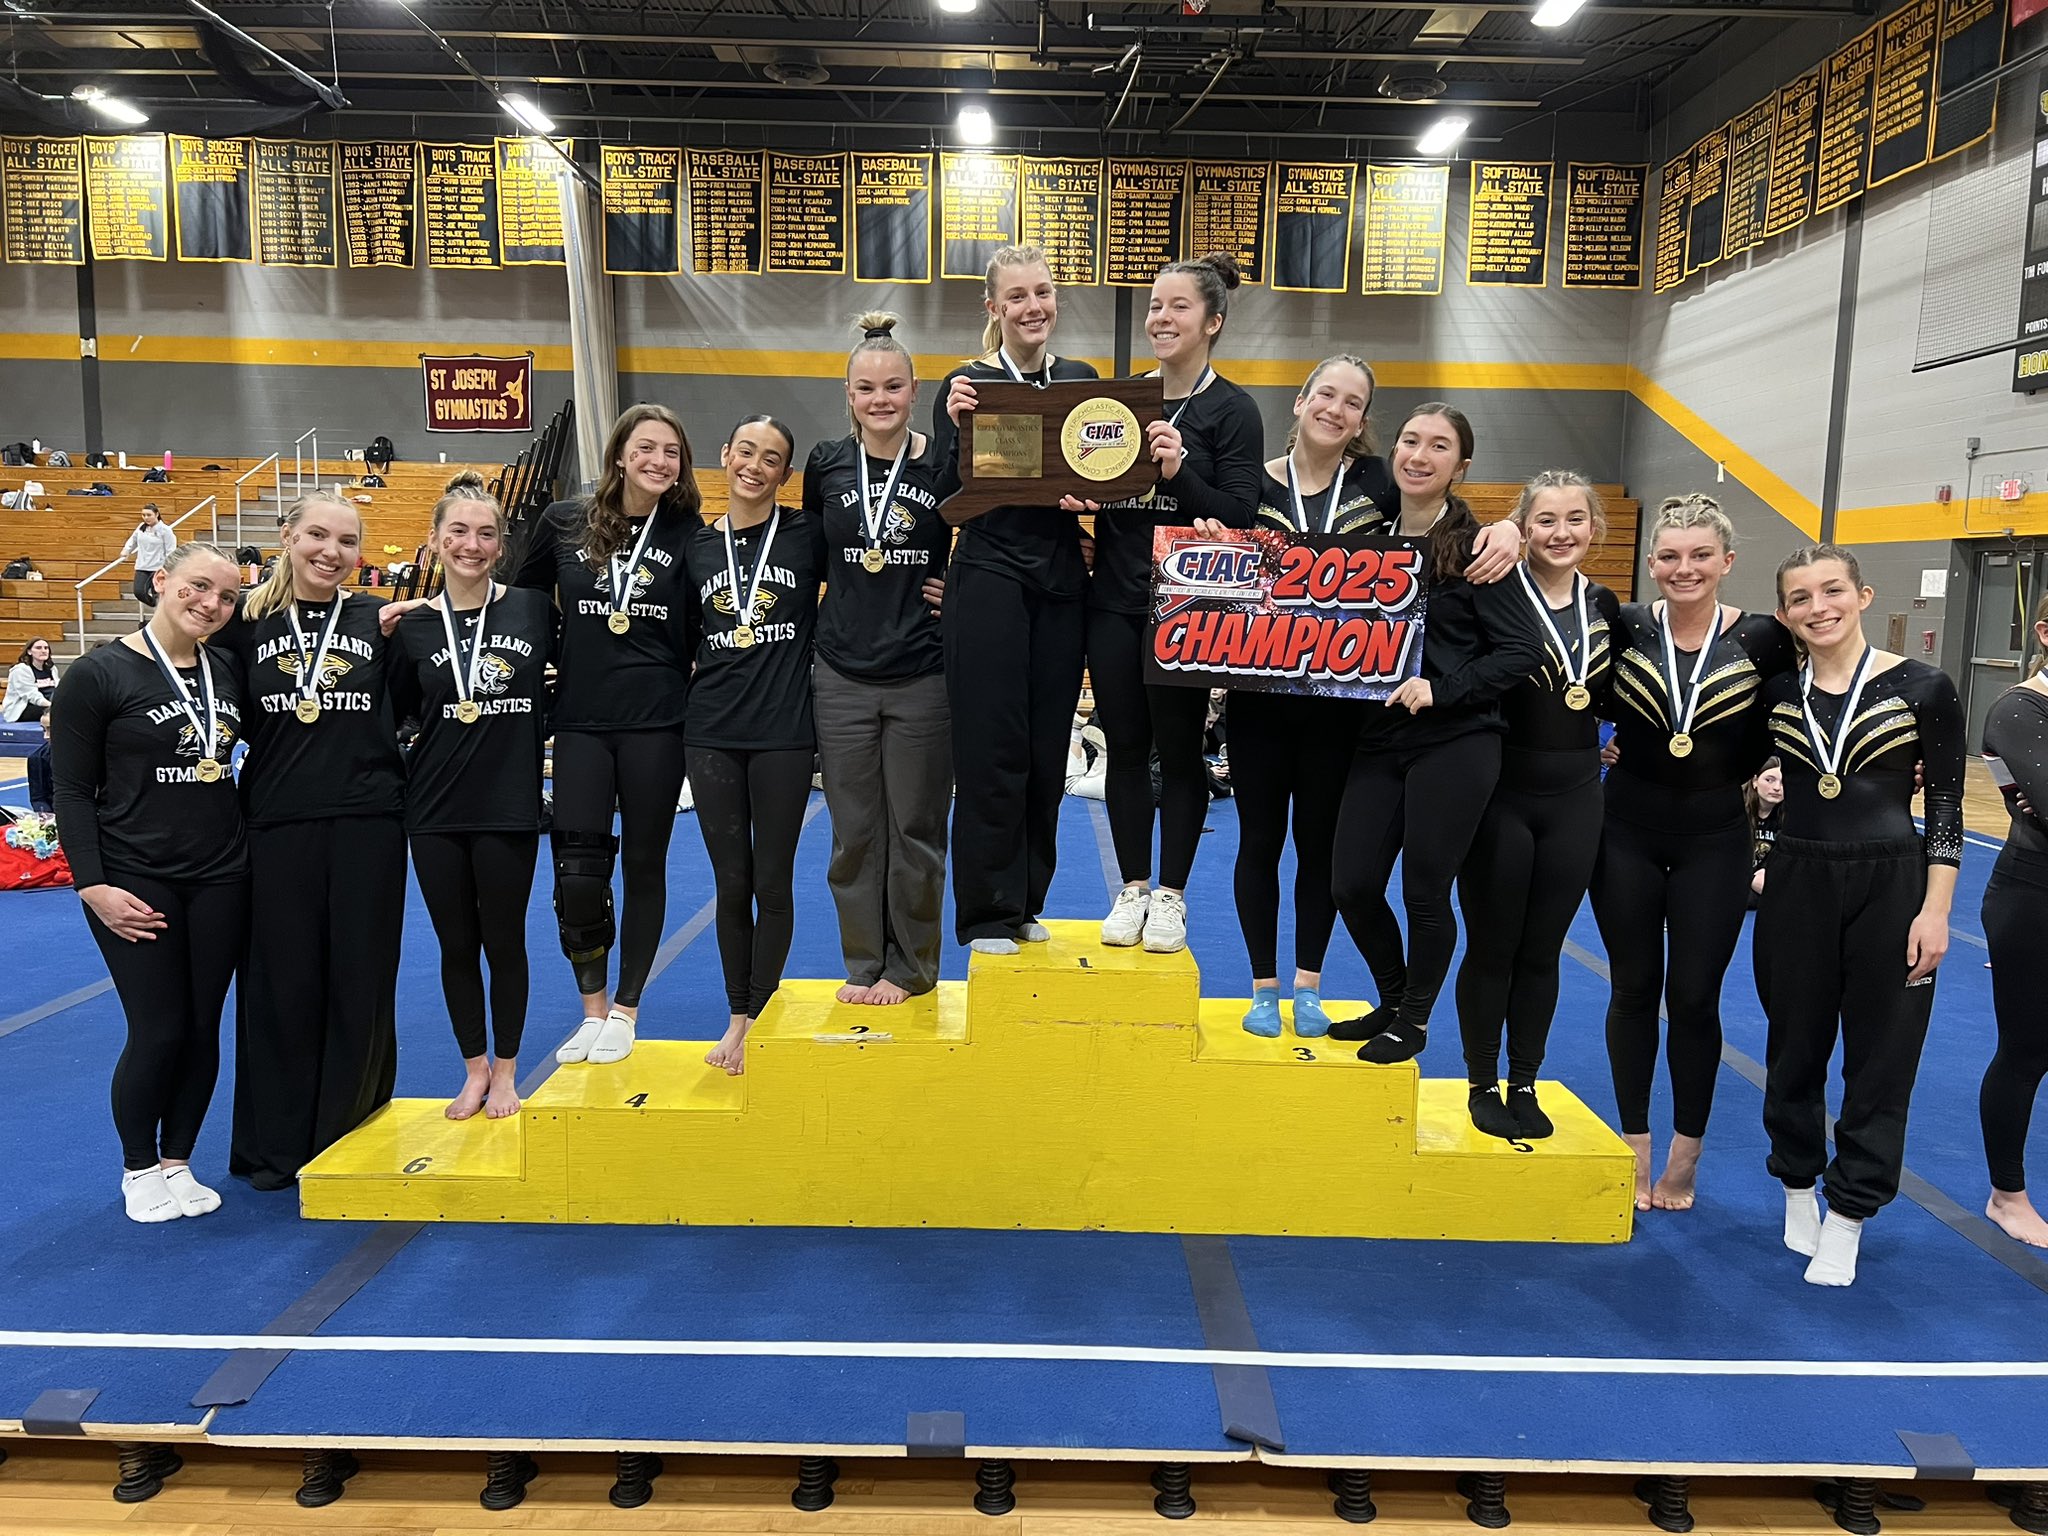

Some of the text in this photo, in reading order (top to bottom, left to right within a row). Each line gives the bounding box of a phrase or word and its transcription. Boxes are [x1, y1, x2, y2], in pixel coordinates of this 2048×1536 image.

[1887, 1, 1936, 39] WRESTLING
[1886, 16, 1935, 58] ALL-STATE
[1832, 35, 1874, 74] WRESTLING
[1830, 52, 1874, 91] ALL-STATE
[1783, 74, 1819, 105] WRESTLING
[1782, 91, 1818, 122] ALL-STATE
[1736, 100, 1774, 132] WRESTLING
[1736, 118, 1772, 150] ALL-STATE
[4, 142, 77, 155] BOYS' SOCCER
[90, 141, 118, 154] BOYS'
[180, 140, 242, 153] BOYS SOCCER
[507, 143, 531, 157] BOYS
[1699, 130, 1727, 156] SOFTBALL
[261, 144, 328, 158] BOYS' TRACK
[345, 146, 410, 157] BOYS TRACK
[432, 150, 490, 163] BOYS TRACK
[1698, 142, 1727, 170] ALL-STATE
[7, 157, 76, 169] ALL-STATE
[92, 156, 160, 169] ALL-STATE
[181, 153, 243, 166] ALL-STATE
[344, 158, 412, 169] ALL-STATE
[606, 152, 676, 165] BOYS TRACK
[692, 154, 758, 166] BASEBALL
[774, 158, 839, 170] BASEBALL
[862, 159, 922, 171] BASEBALL
[260, 160, 330, 173] ALL-STATE
[431, 163, 493, 177] ALL-STATE
[611, 166, 672, 178] ALL-STATE
[692, 166, 760, 178] ALL-STATE
[1024, 163, 1098, 176] GYMNASTICS
[1112, 164, 1184, 176] GYMNASTICS
[1196, 166, 1265, 178] GYMNASTICS
[1482, 167, 1542, 179] SOFTBALL
[1665, 160, 1690, 181] SOFTBALL
[774, 172, 840, 184] ALL-STATE
[861, 173, 923, 185] ALL-STATE
[1288, 168, 1344, 181] GYMNASTICS
[1375, 172, 1441, 186] SOFTBALL
[1577, 169, 1637, 181] SOFTBALL
[1028, 178, 1097, 191] ALL-STATE
[1116, 178, 1179, 190] ALL-STATE
[1200, 180, 1261, 192] ALL-STATE
[1285, 181, 1346, 194] ALL-STATE
[1480, 180, 1543, 193] ALL-STATE
[1575, 183, 1639, 195] ALL-STATE
[1664, 169, 1690, 195] ALL-STATE
[1373, 187, 1441, 200] ALL-STATE
[2024, 266, 2035, 280] TM
[431, 368, 497, 390] ST JOSEPH
[435, 398, 508, 420] GYMNASTICS
[1067, 404, 1115, 438] INTERSCHOLASTIC
[1116, 409, 1136, 436] ATHLETIC
[1086, 424, 1124, 440] CIAC
[1067, 441, 1101, 475] CONNECTICUT
[1105, 439, 1135, 474] CONFERENCE
[840, 483, 936, 510] DAIE HAND
[2003, 480, 2019, 499] EXIT
[644, 546, 672, 568] AND
[844, 548, 929, 565] GYASTICS
[1176, 546, 1419, 606] CIAC 2025
[700, 564, 796, 604] DANIL AND
[578, 600, 668, 620] GYMSTICS
[707, 622, 795, 650] GYMSTICS
[258, 632, 373, 664] DANEL HAND
[430, 634, 532, 668] DAIL HAND
[1154, 610, 1411, 678] CHAMPION
[261, 692, 371, 713] GYMASTICS
[443, 698, 532, 718] GYNASTICS
[146, 697, 204, 725] DANL
[1078, 958, 1093, 968] 1
[850, 1026, 870, 1034] 2
[1292, 1047, 1316, 1061] 3
[624, 1093, 649, 1108] 4
[1506, 1138, 1534, 1152] 5
[403, 1156, 432, 1174] 6
